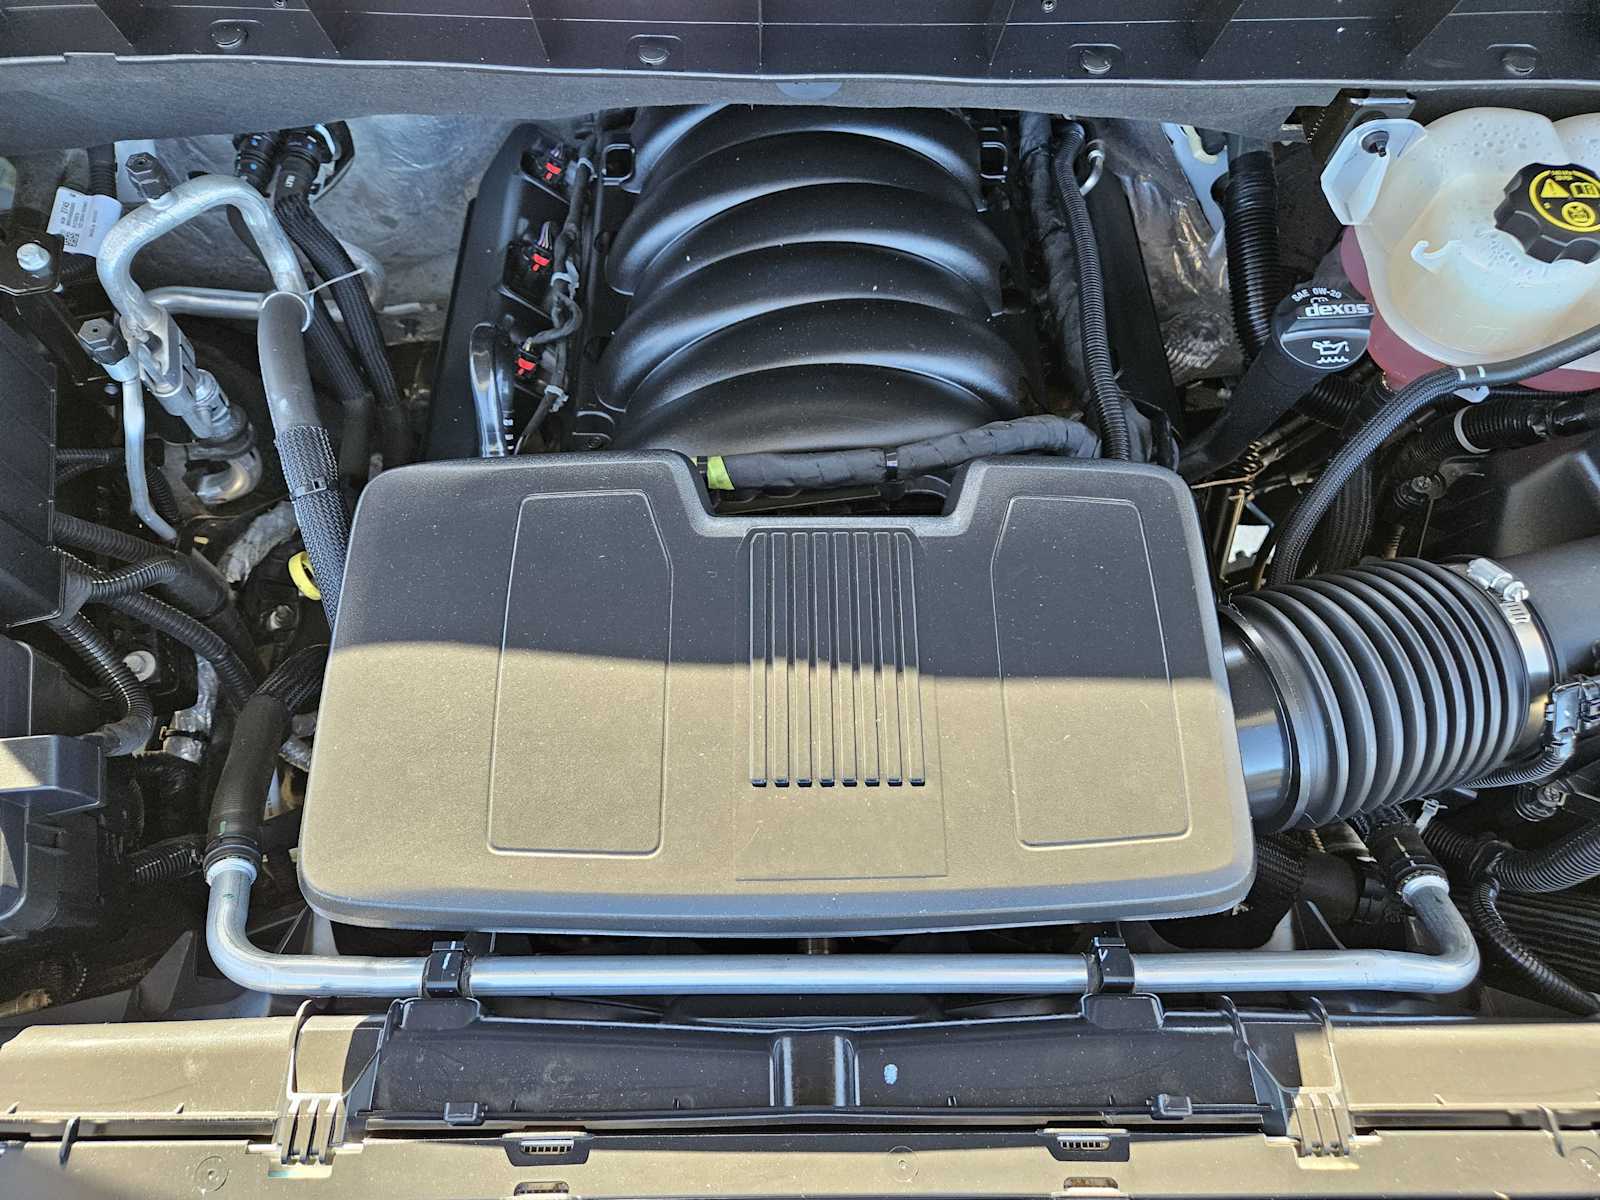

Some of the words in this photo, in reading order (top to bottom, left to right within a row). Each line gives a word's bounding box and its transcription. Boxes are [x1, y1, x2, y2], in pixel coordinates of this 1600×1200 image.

[1291, 289, 1311, 302] SAE
[1312, 287, 1342, 299] 0W-20
[1305, 303, 1370, 317] dexos
